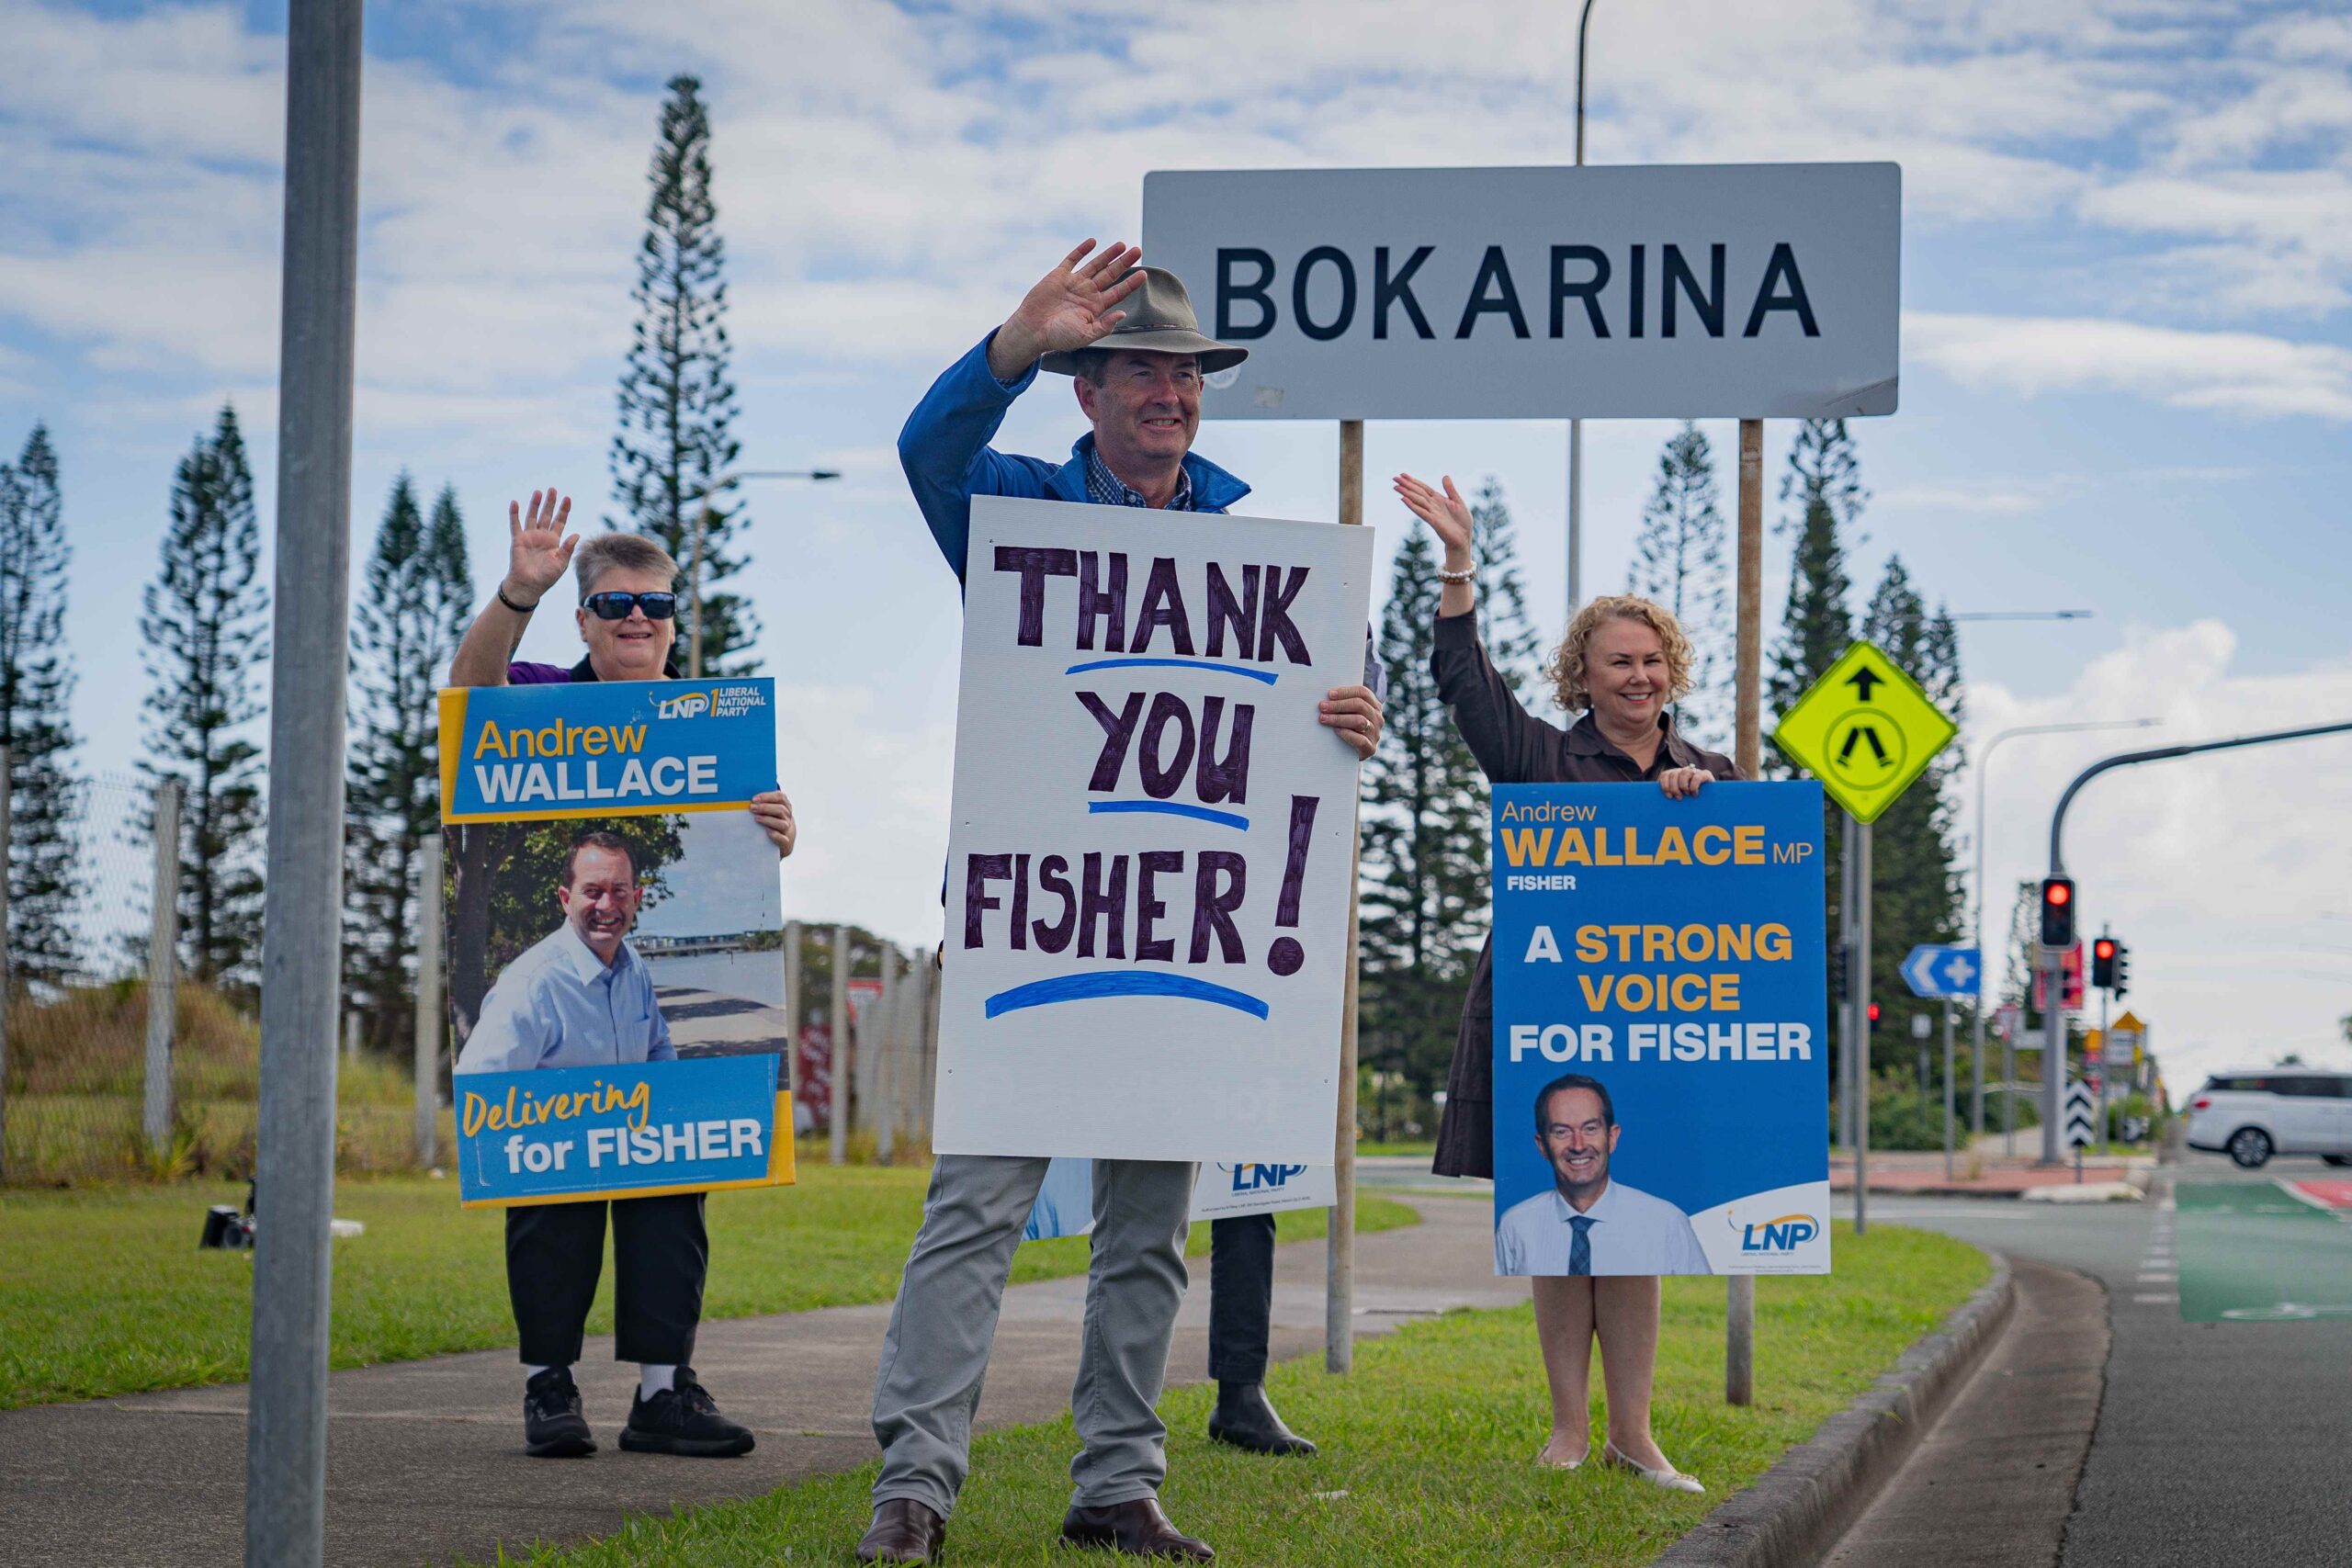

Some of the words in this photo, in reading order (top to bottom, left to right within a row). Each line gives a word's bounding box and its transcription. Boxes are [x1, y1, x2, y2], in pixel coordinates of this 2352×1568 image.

[1215, 242, 1821, 341] BOKARINA
[993, 545, 1313, 667] THANK
[658, 699, 706, 720] LNP
[716, 706, 750, 717] PARTY
[718, 686, 761, 697] LIBERAL
[718, 696, 767, 707] NATIONAL
[473, 718, 648, 760] Andrew
[1074, 691, 1256, 806] YOU
[473, 755, 719, 805] WALLACE
[1500, 800, 1598, 822] Andrew
[1499, 825, 1767, 867] WALLACE
[1772, 841, 1814, 865] MP
[1506, 874, 1577, 891] FISHER
[1522, 925, 1564, 964] A
[1575, 922, 1793, 964] STRONG
[1577, 973, 1742, 1012] VOICE
[1509, 1023, 1615, 1064] FOR
[1627, 1021, 1814, 1062] FISHER
[462, 1079, 650, 1138] Delivering
[503, 1134, 574, 1175] for
[586, 1117, 763, 1168] FISHER
[1232, 1163, 1303, 1191] LNP
[1742, 1222, 1814, 1251] LNP
